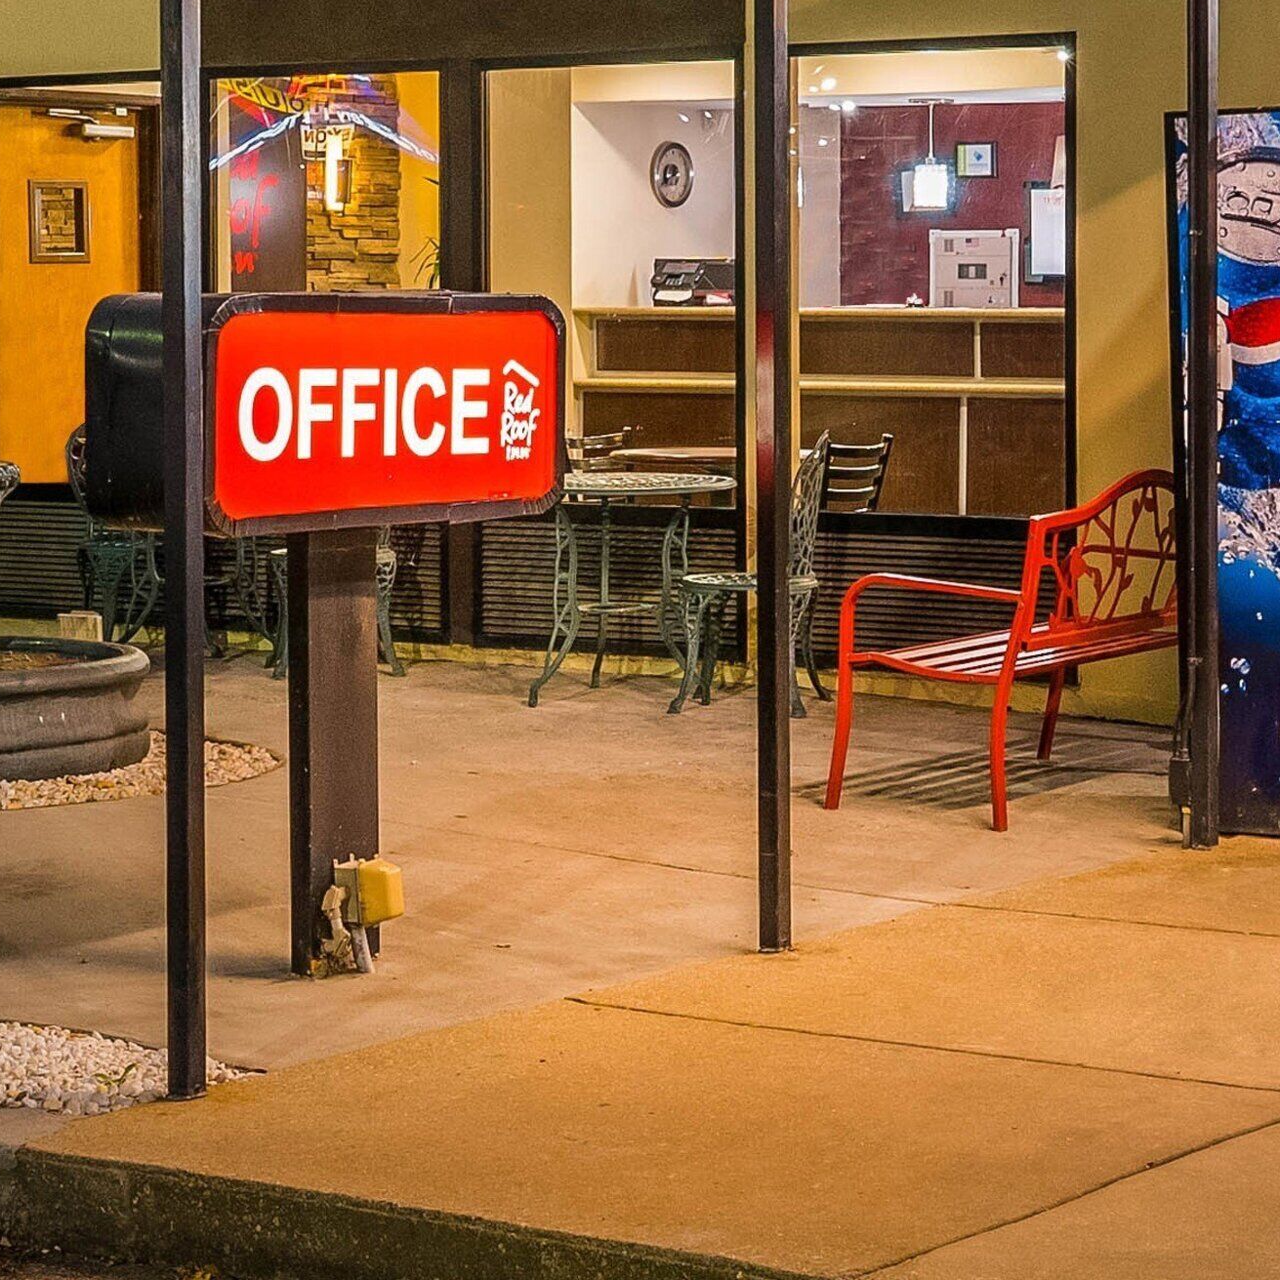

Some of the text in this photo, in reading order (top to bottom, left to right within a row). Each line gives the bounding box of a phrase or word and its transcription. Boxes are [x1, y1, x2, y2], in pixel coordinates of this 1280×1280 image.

[237, 366, 491, 462] OFFICE
[503, 380, 535, 415] Red
[500, 408, 541, 448] Roof
